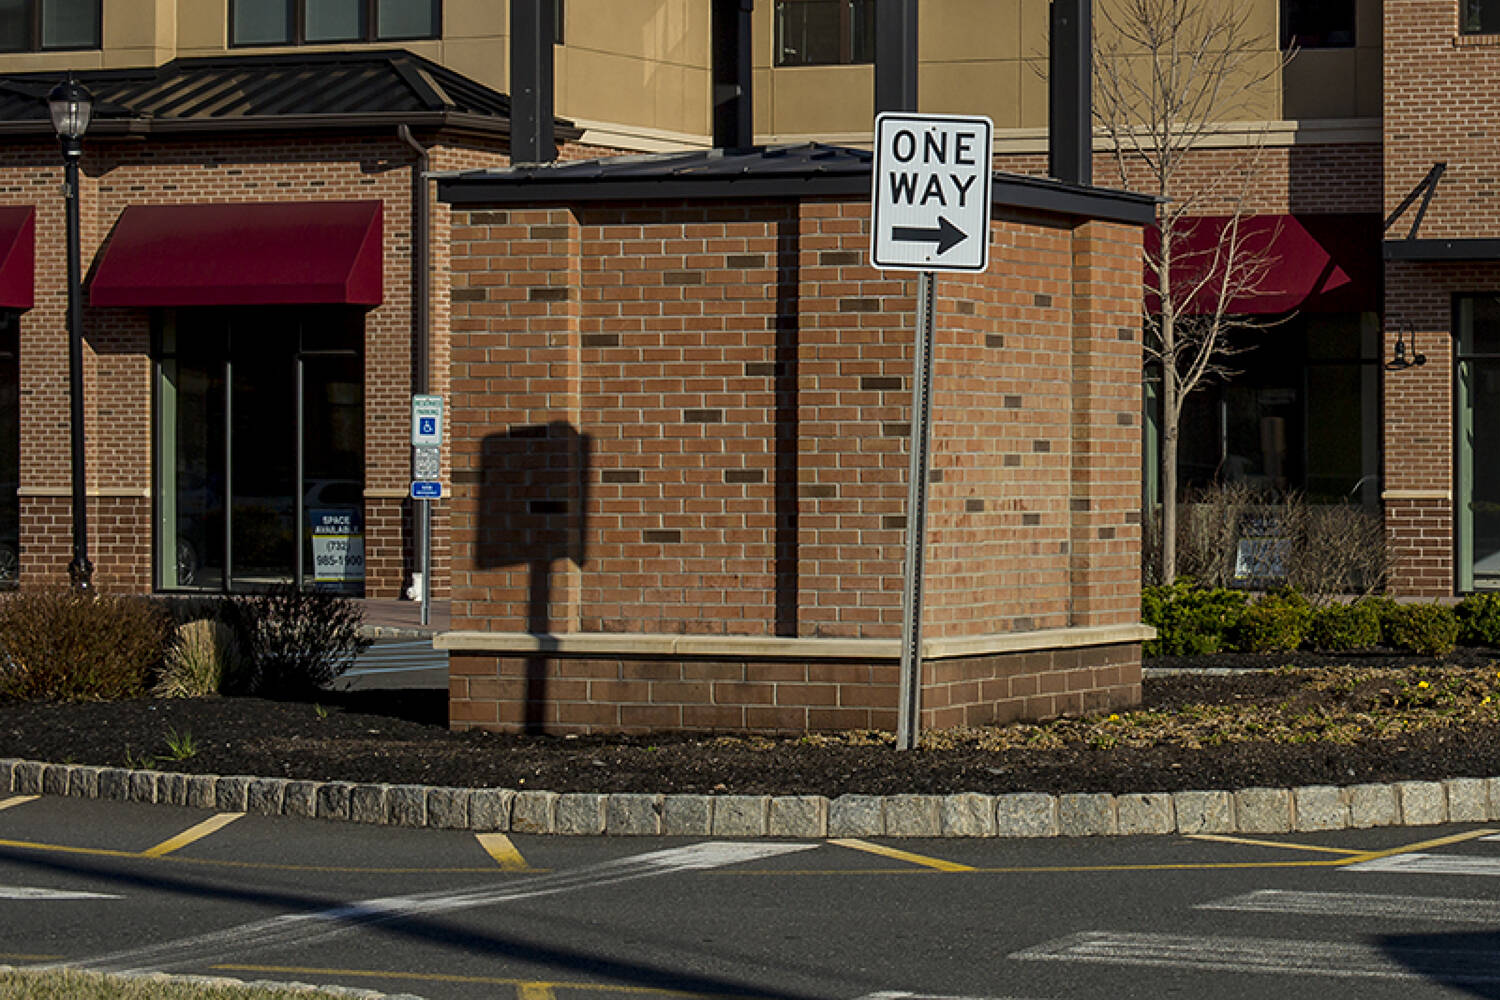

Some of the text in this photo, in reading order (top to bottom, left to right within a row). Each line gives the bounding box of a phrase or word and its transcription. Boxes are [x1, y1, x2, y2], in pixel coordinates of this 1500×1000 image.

[892, 129, 976, 165] ONE
[889, 171, 977, 208] WAY
[322, 515, 351, 525] SPACE
